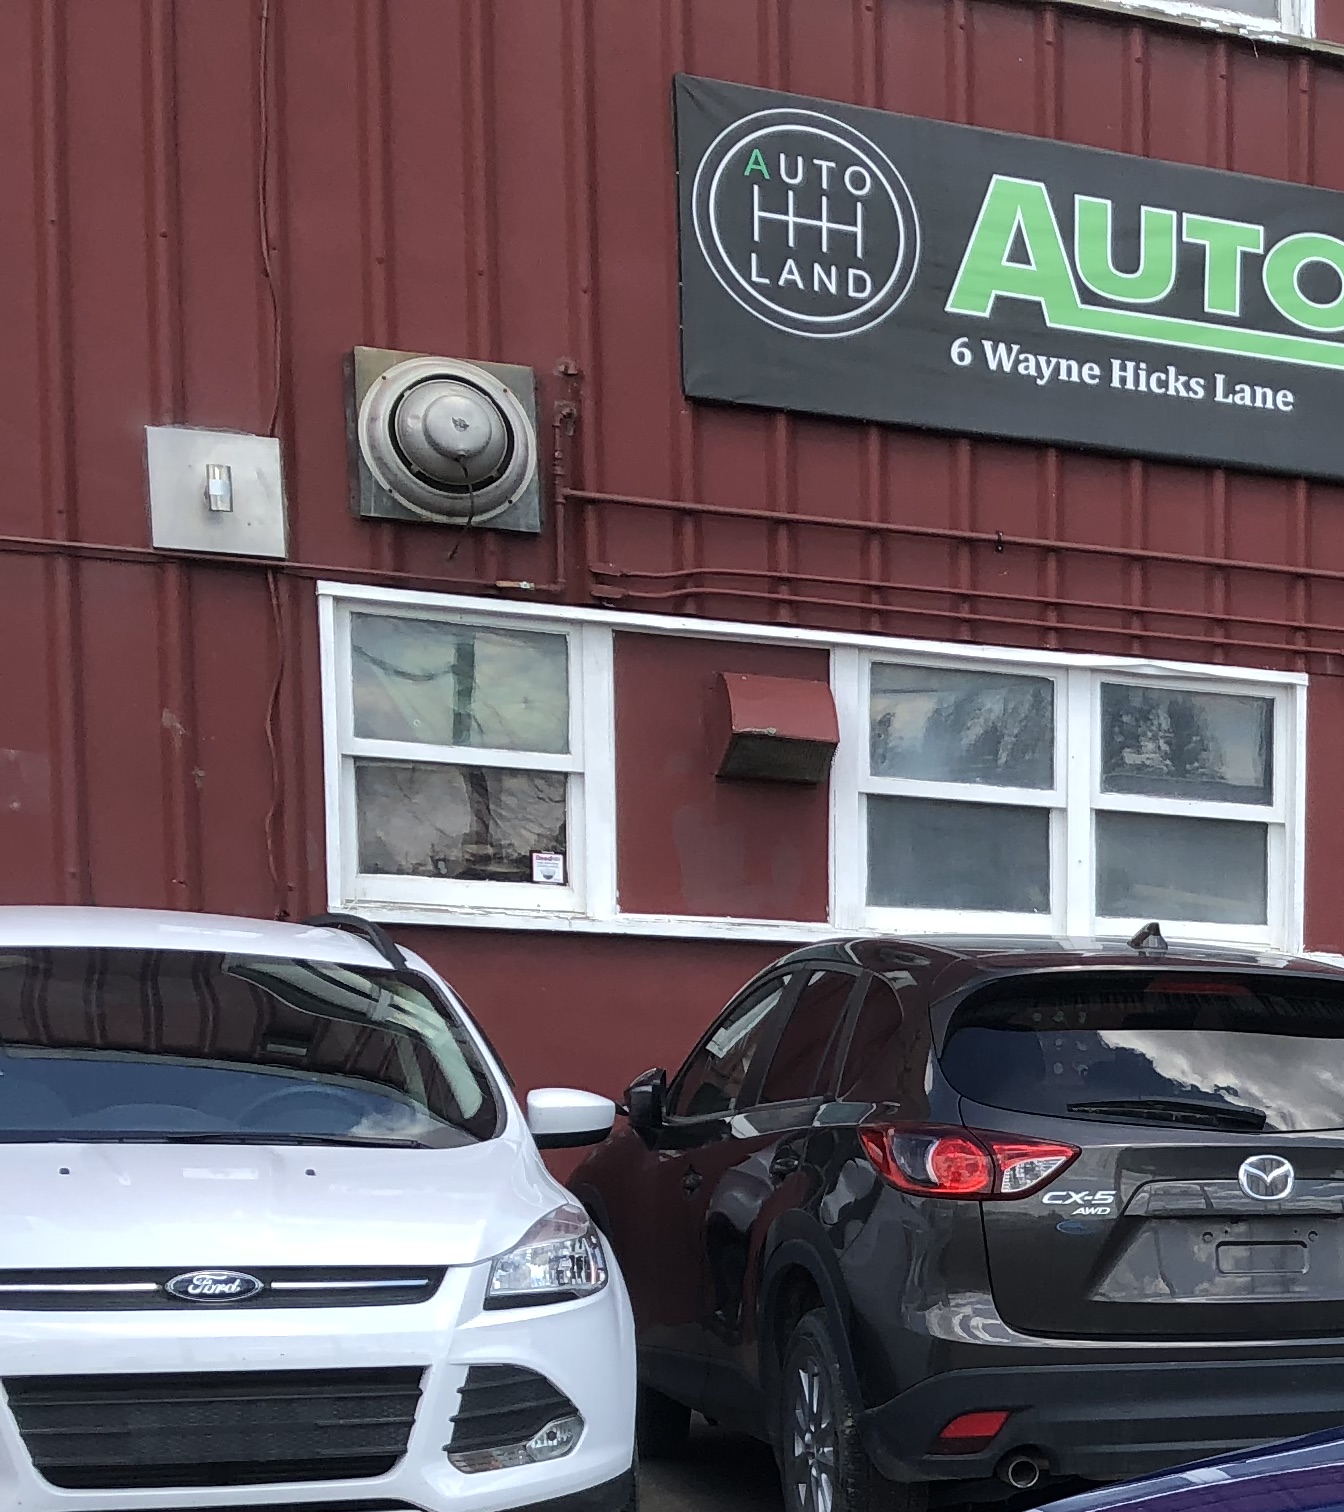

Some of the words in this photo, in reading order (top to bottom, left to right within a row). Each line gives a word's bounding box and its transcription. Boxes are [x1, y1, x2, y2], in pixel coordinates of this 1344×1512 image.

[744, 149, 871, 195] AUTO
[751, 253, 872, 298] LAND
[950, 337, 972, 366] 6
[981, 339, 1101, 386] Wayne
[1110, 358, 1205, 400] Hicks
[1214, 373, 1294, 411] Lane
[1041, 1190, 1117, 1205] CX-5
[1070, 1206, 1111, 1216] AWD
[187, 1274, 241, 1295] Ford
